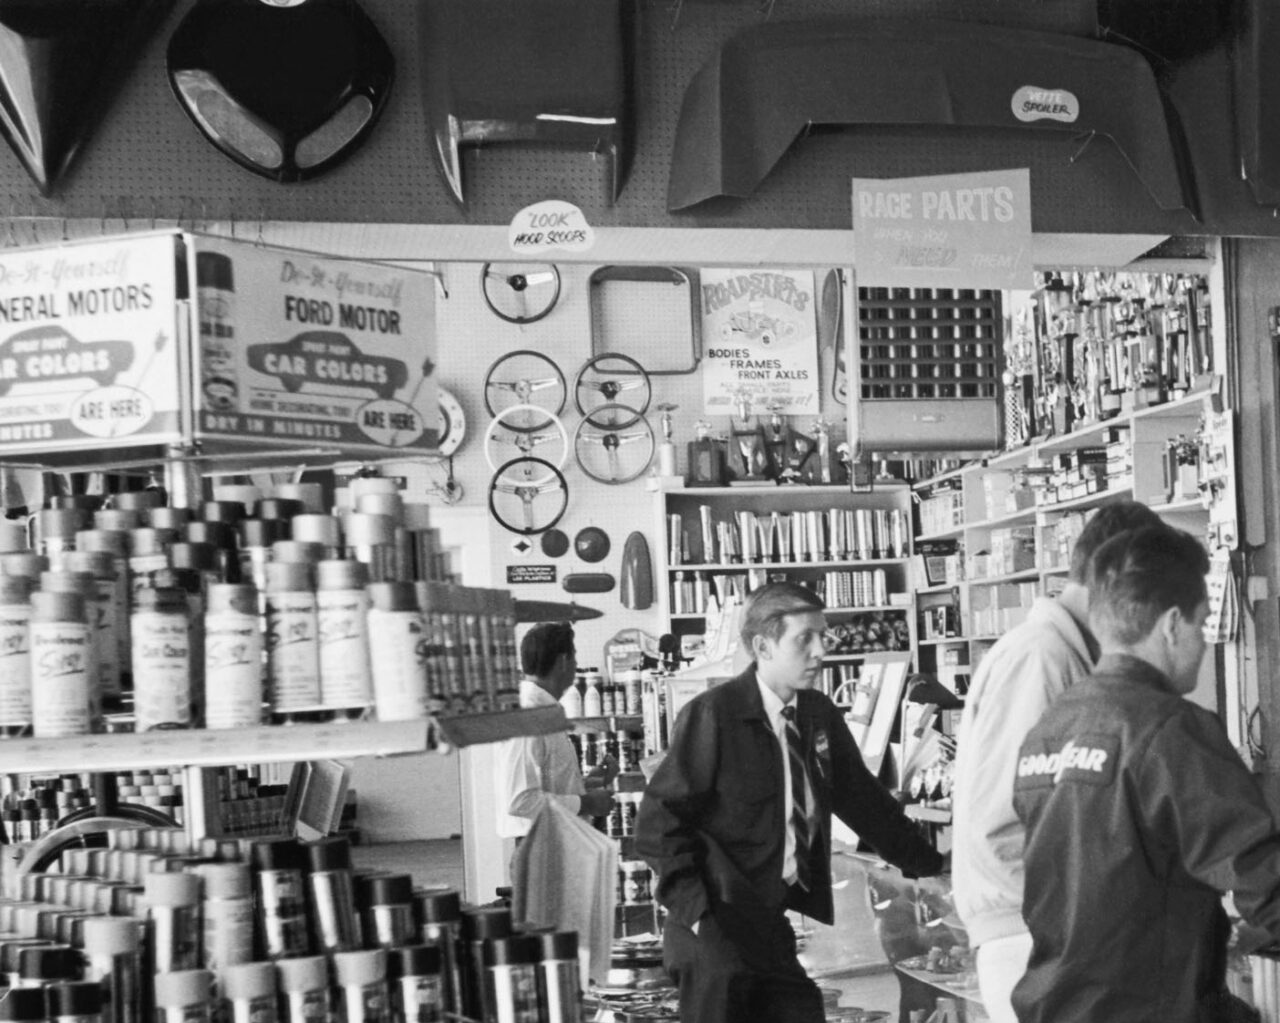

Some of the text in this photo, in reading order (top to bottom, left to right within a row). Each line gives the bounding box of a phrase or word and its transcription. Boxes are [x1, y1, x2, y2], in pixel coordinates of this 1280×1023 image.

[1022, 101, 1071, 115] SPOILER
[858, 186, 1014, 223] RACE PARTS
[513, 230, 586, 247] HOOD SCOOPS
[0, 283, 153, 323] NERAL MOTORS
[285, 295, 402, 334] FORD MOTOR
[25, 349, 110, 378] COLORS
[708, 349, 750, 358] BODIES
[264, 353, 388, 384] CAR COLORS
[730, 360, 782, 369] FRAMES
[738, 370, 809, 380] FRONT AXLES
[80, 402, 104, 420] ARE
[109, 398, 141, 418] HERE
[0, 423, 53, 440] NUTES
[247, 417, 265, 432] IN
[273, 419, 342, 438] MINUTES
[363, 411, 416, 432] ARE HERE
